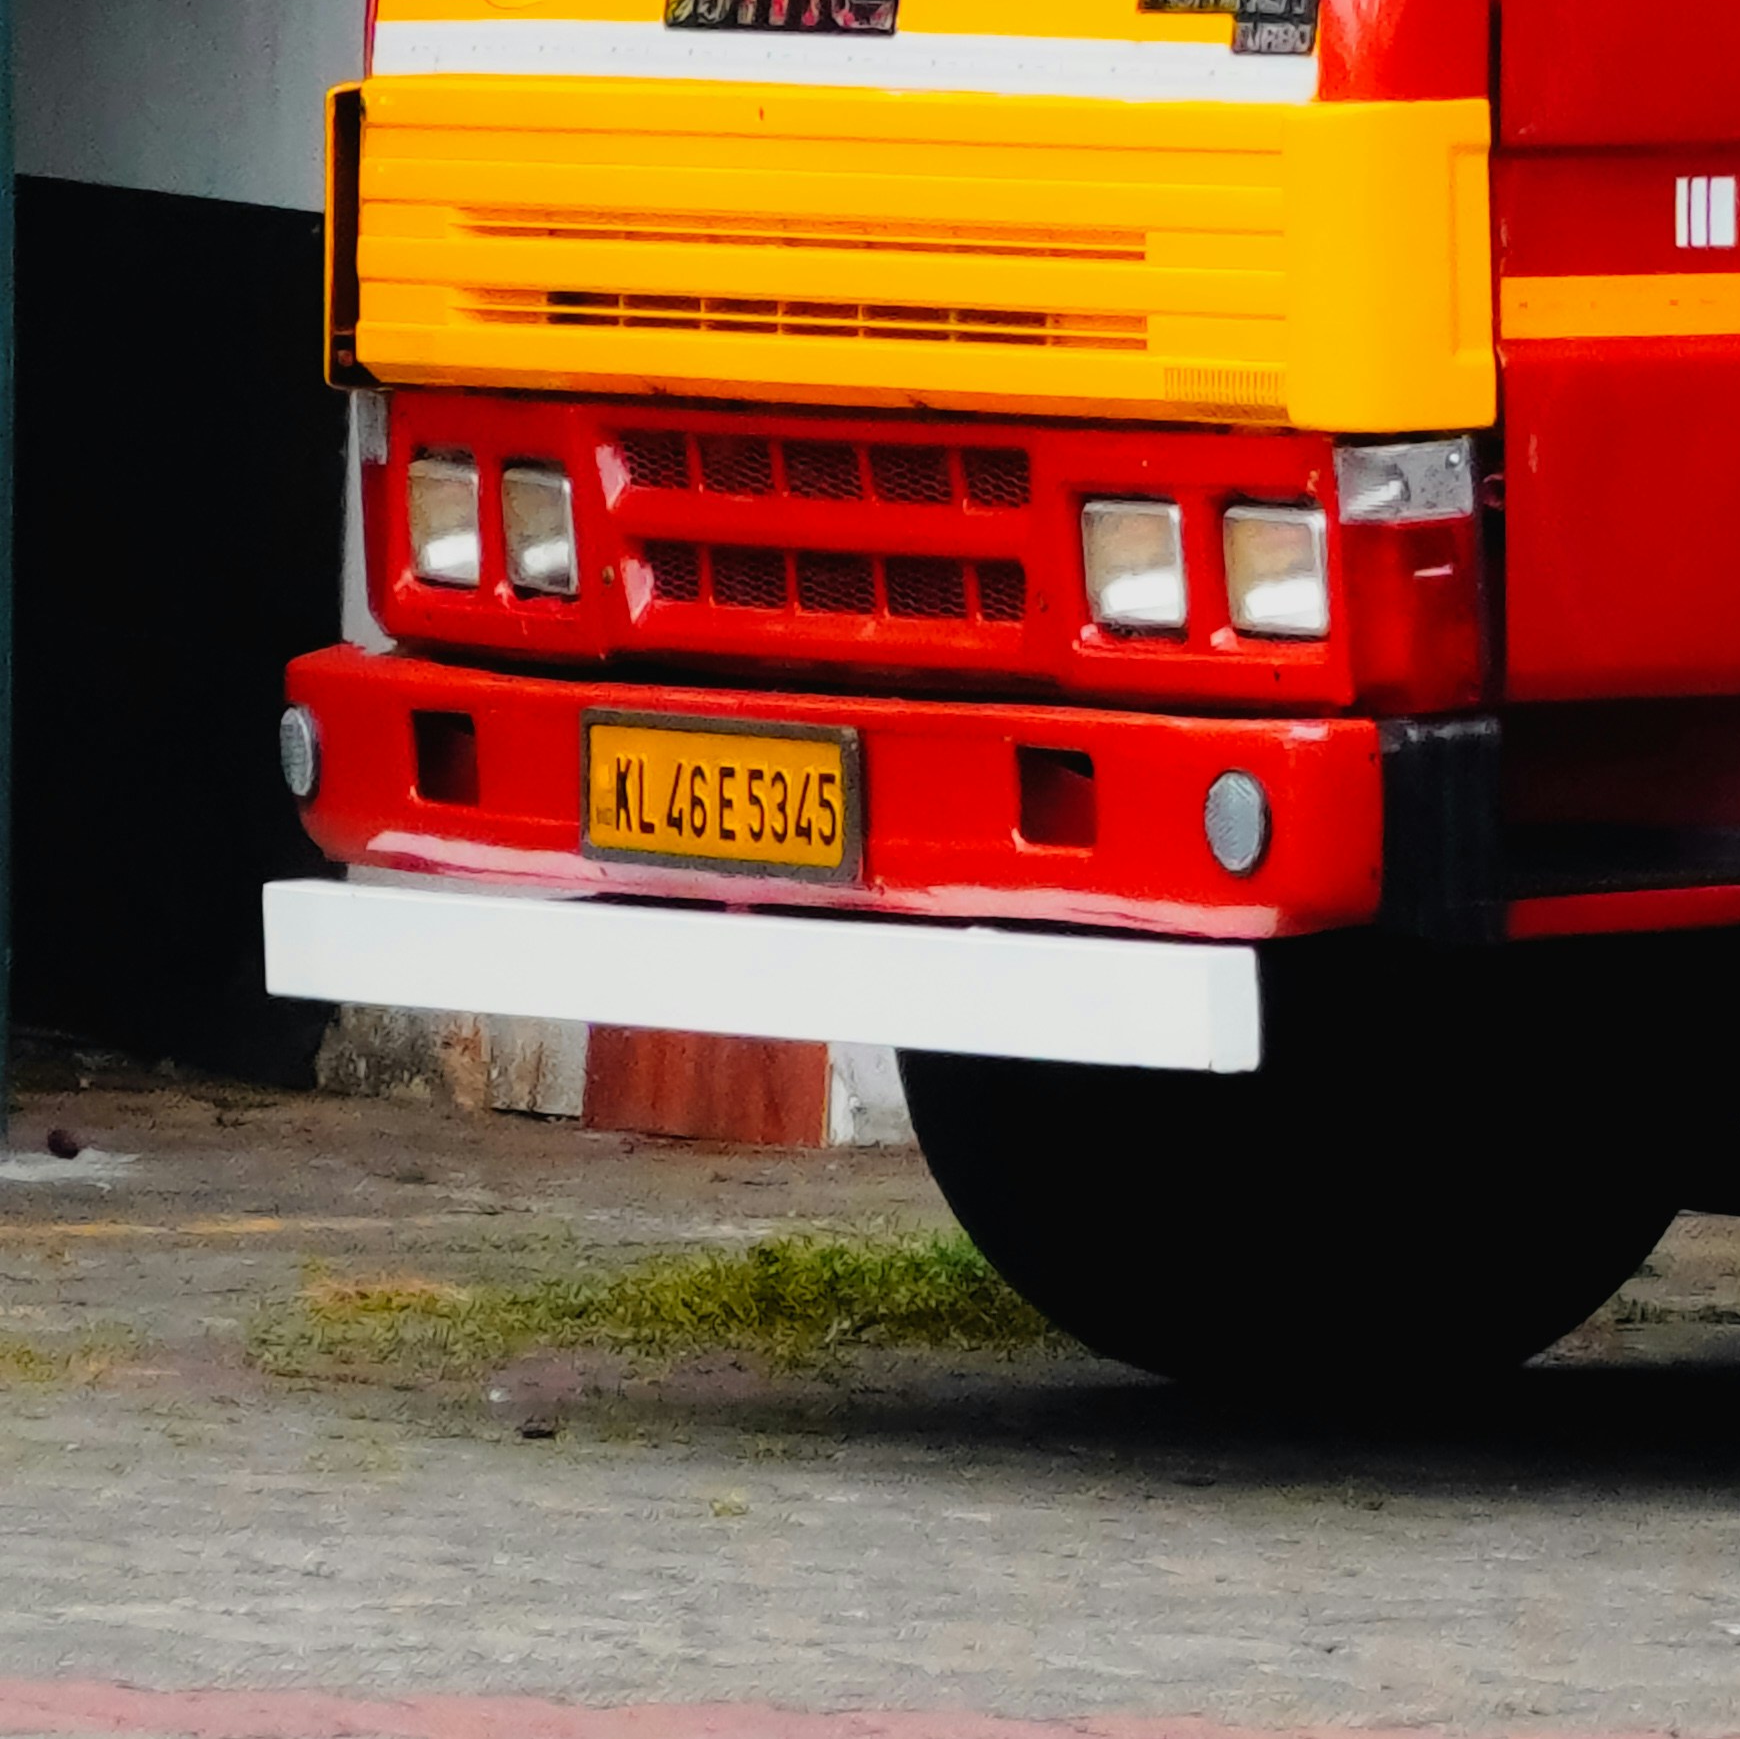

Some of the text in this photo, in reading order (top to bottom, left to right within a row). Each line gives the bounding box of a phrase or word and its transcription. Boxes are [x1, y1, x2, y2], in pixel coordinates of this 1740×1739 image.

[615, 756, 838, 846] KL 46 E 5345
